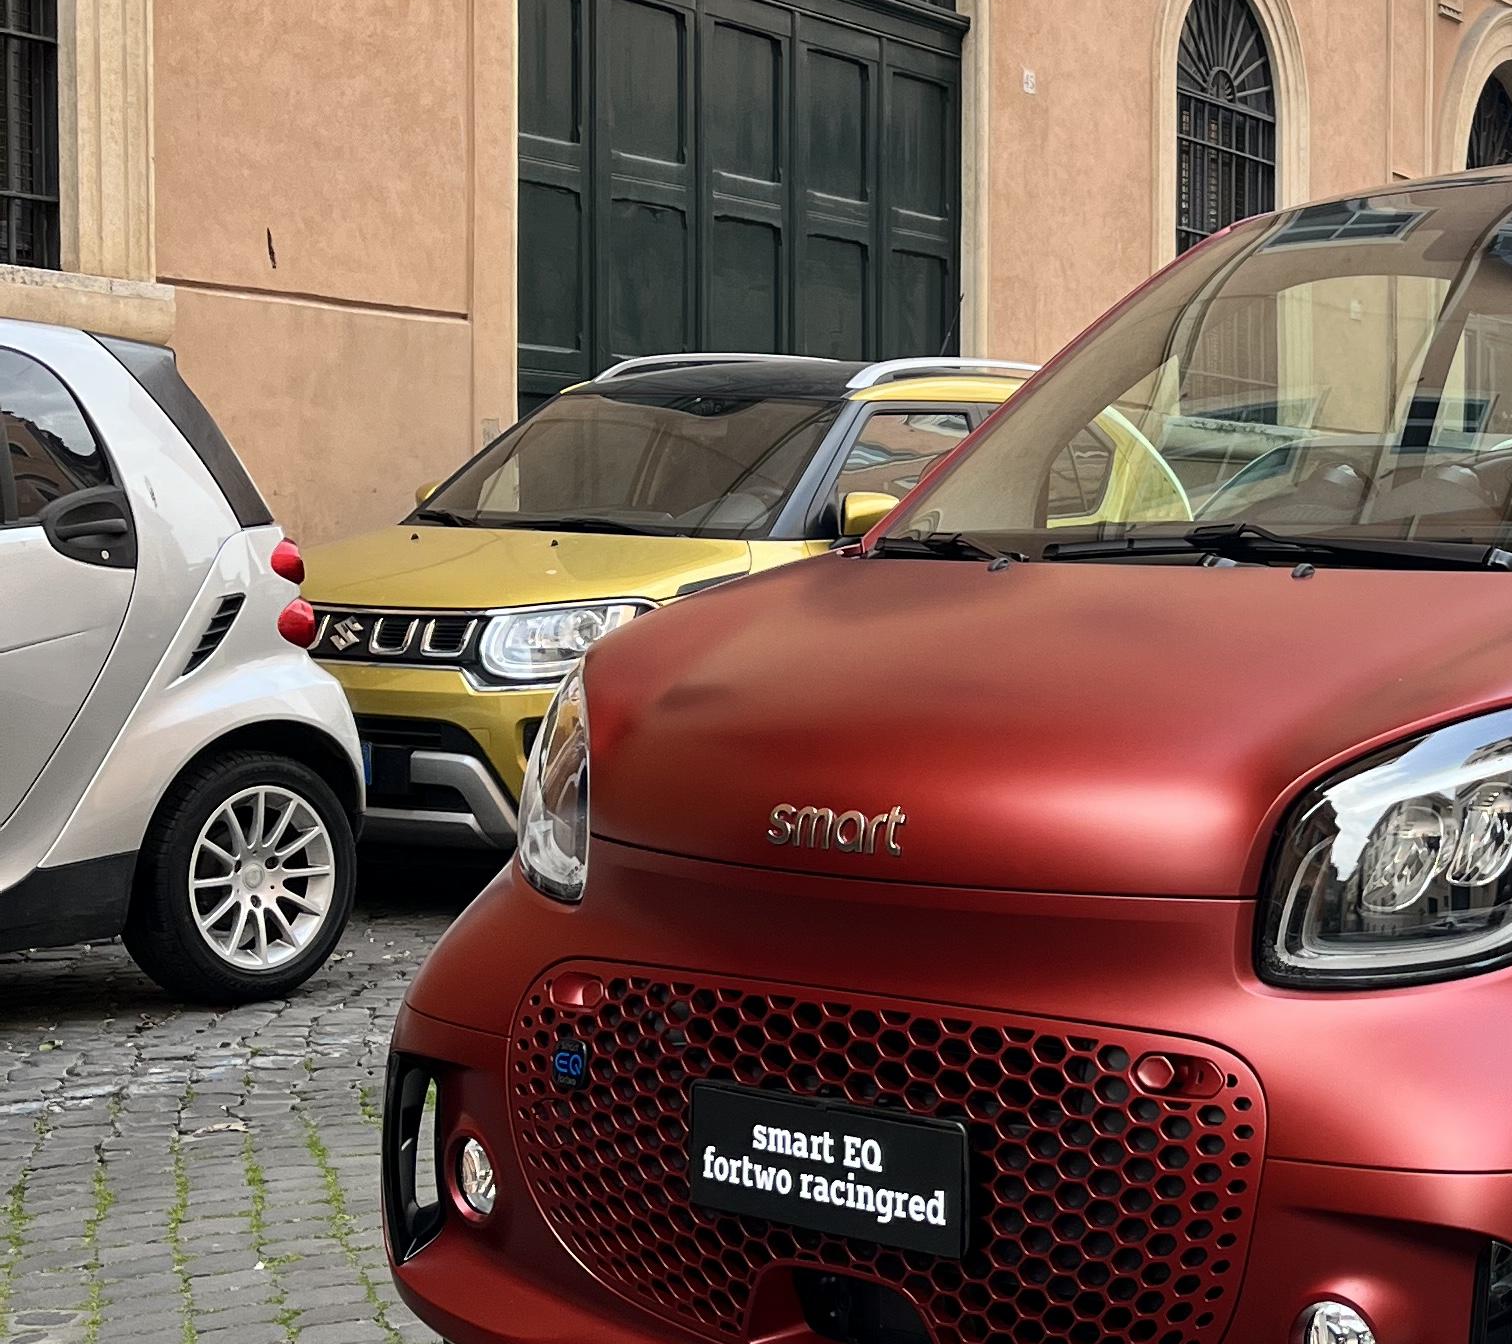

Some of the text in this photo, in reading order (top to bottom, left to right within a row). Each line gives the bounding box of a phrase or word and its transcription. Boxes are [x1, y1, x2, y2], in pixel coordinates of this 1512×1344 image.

[767, 803, 906, 856] smart
[555, 1052, 582, 1075] EQ
[752, 1123, 883, 1173] smart EQ
[702, 1145, 947, 1226] fortwo racingred
